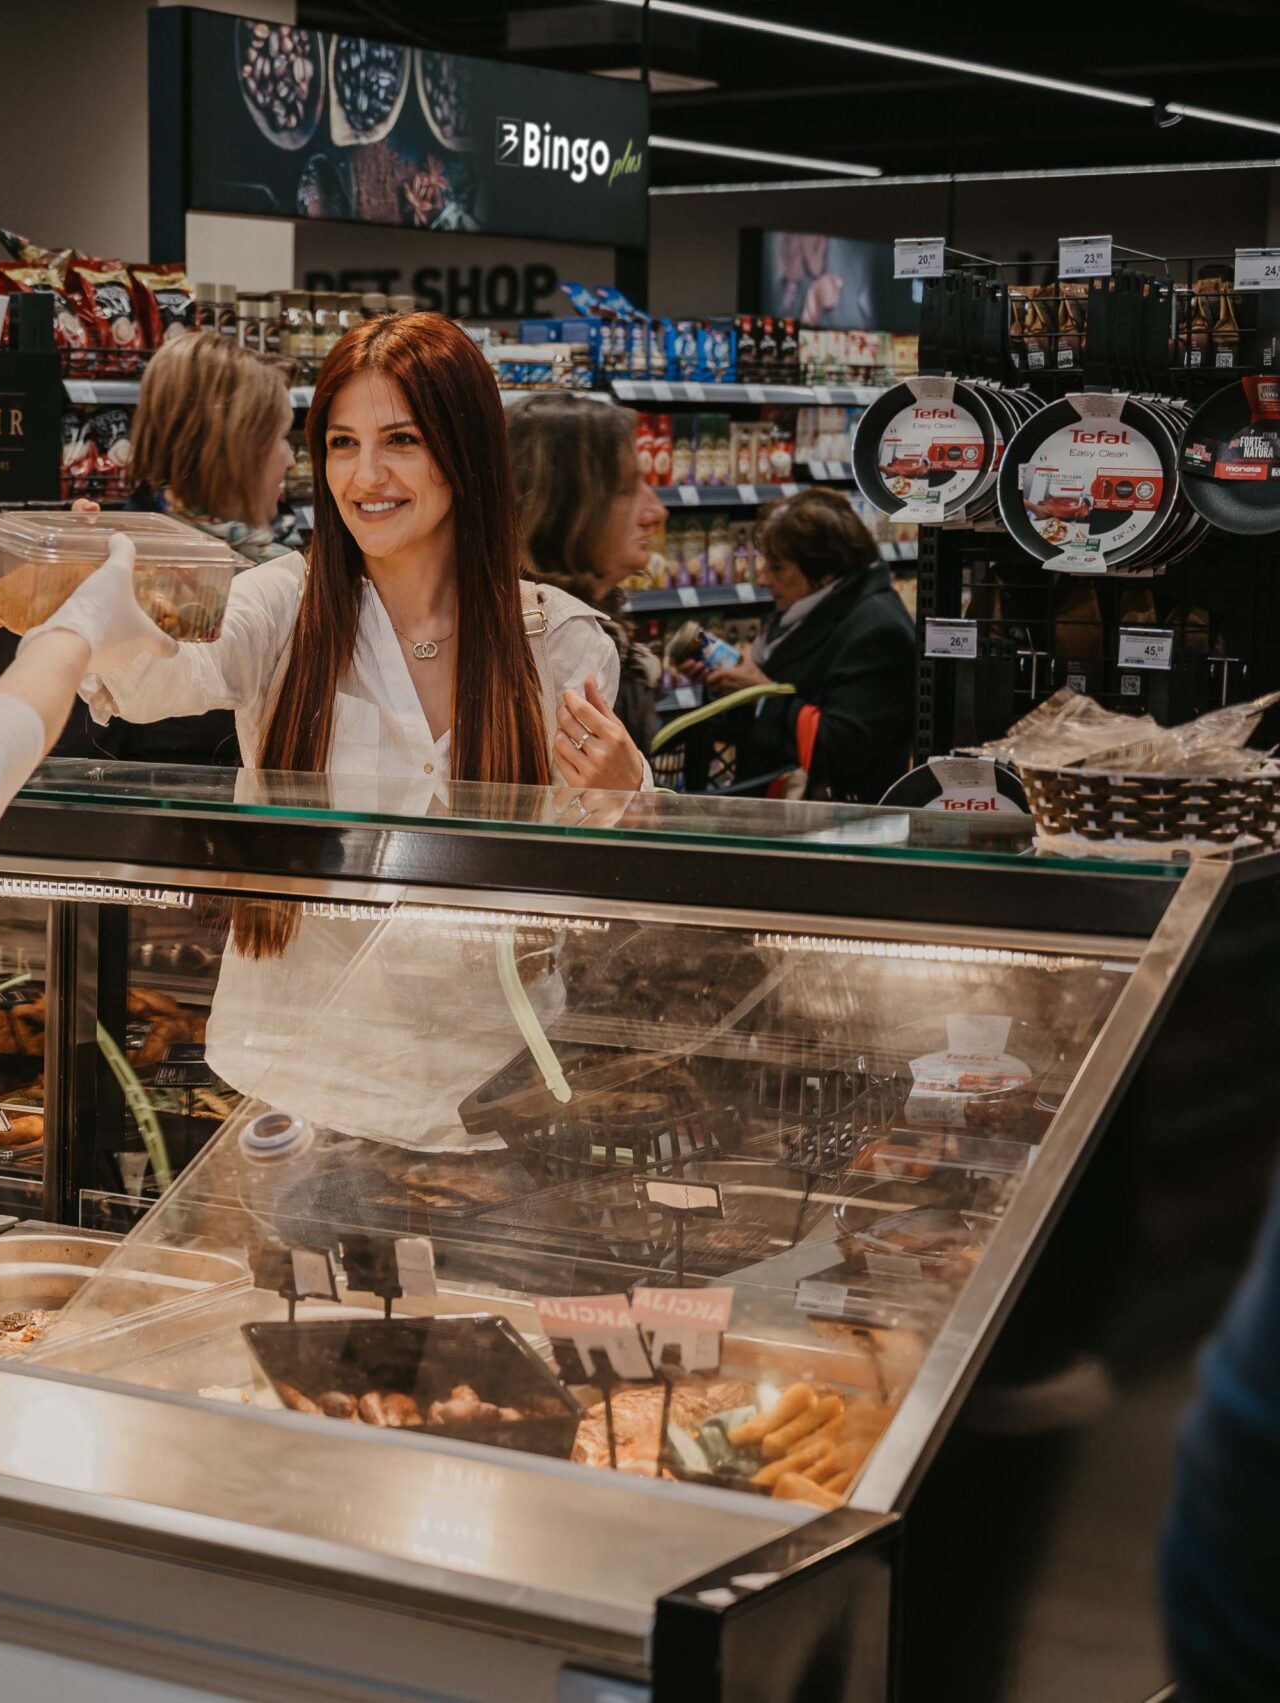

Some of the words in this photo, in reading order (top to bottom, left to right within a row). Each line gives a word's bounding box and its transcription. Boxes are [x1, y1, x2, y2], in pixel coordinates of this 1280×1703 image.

[523, 121, 610, 183] Bingo
[608, 138, 642, 188] plus
[412, 264, 558, 317] SHOP
[913, 408, 957, 419] Tefal
[1069, 430, 1131, 445] Tefal
[1240, 436, 1262, 448] FORTE
[1070, 448, 1095, 458] Easy
[1099, 449, 1128, 458] Clean
[1243, 446, 1274, 458] NATURA
[940, 798, 999, 811] Tefal
